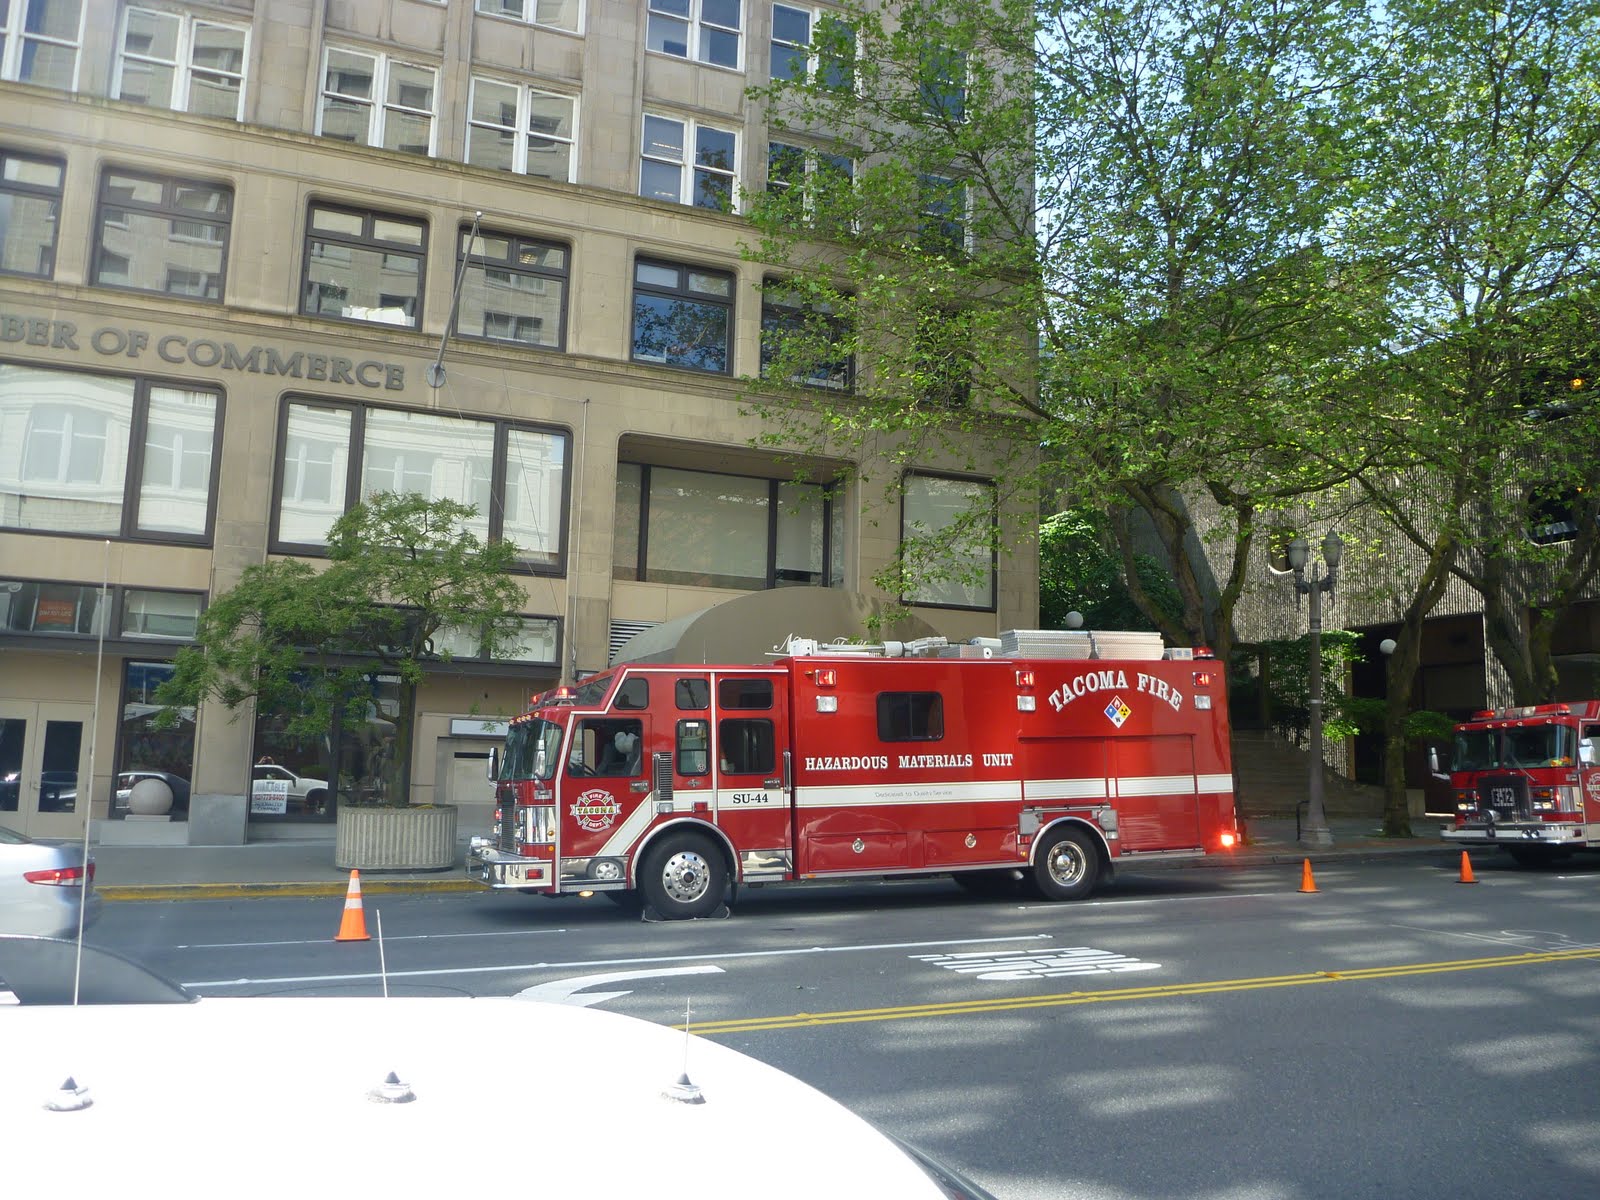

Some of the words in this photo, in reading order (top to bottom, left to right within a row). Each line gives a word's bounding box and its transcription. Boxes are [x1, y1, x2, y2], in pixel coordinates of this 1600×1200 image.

[0, 314, 79, 351] BER
[91, 326, 148, 357] OF
[157, 335, 405, 391] COMMERCE
[1048, 670, 1129, 712] TACOMA
[1136, 672, 1183, 712] FIRE
[805, 755, 888, 770] HAZARDOUS
[898, 754, 973, 768] MATERIALS
[982, 753, 1013, 767] UNIT
[255, 782, 285, 792] AVAILABLE
[733, 793, 768, 804] SU-44
[907, 946, 1162, 981] ONLY
